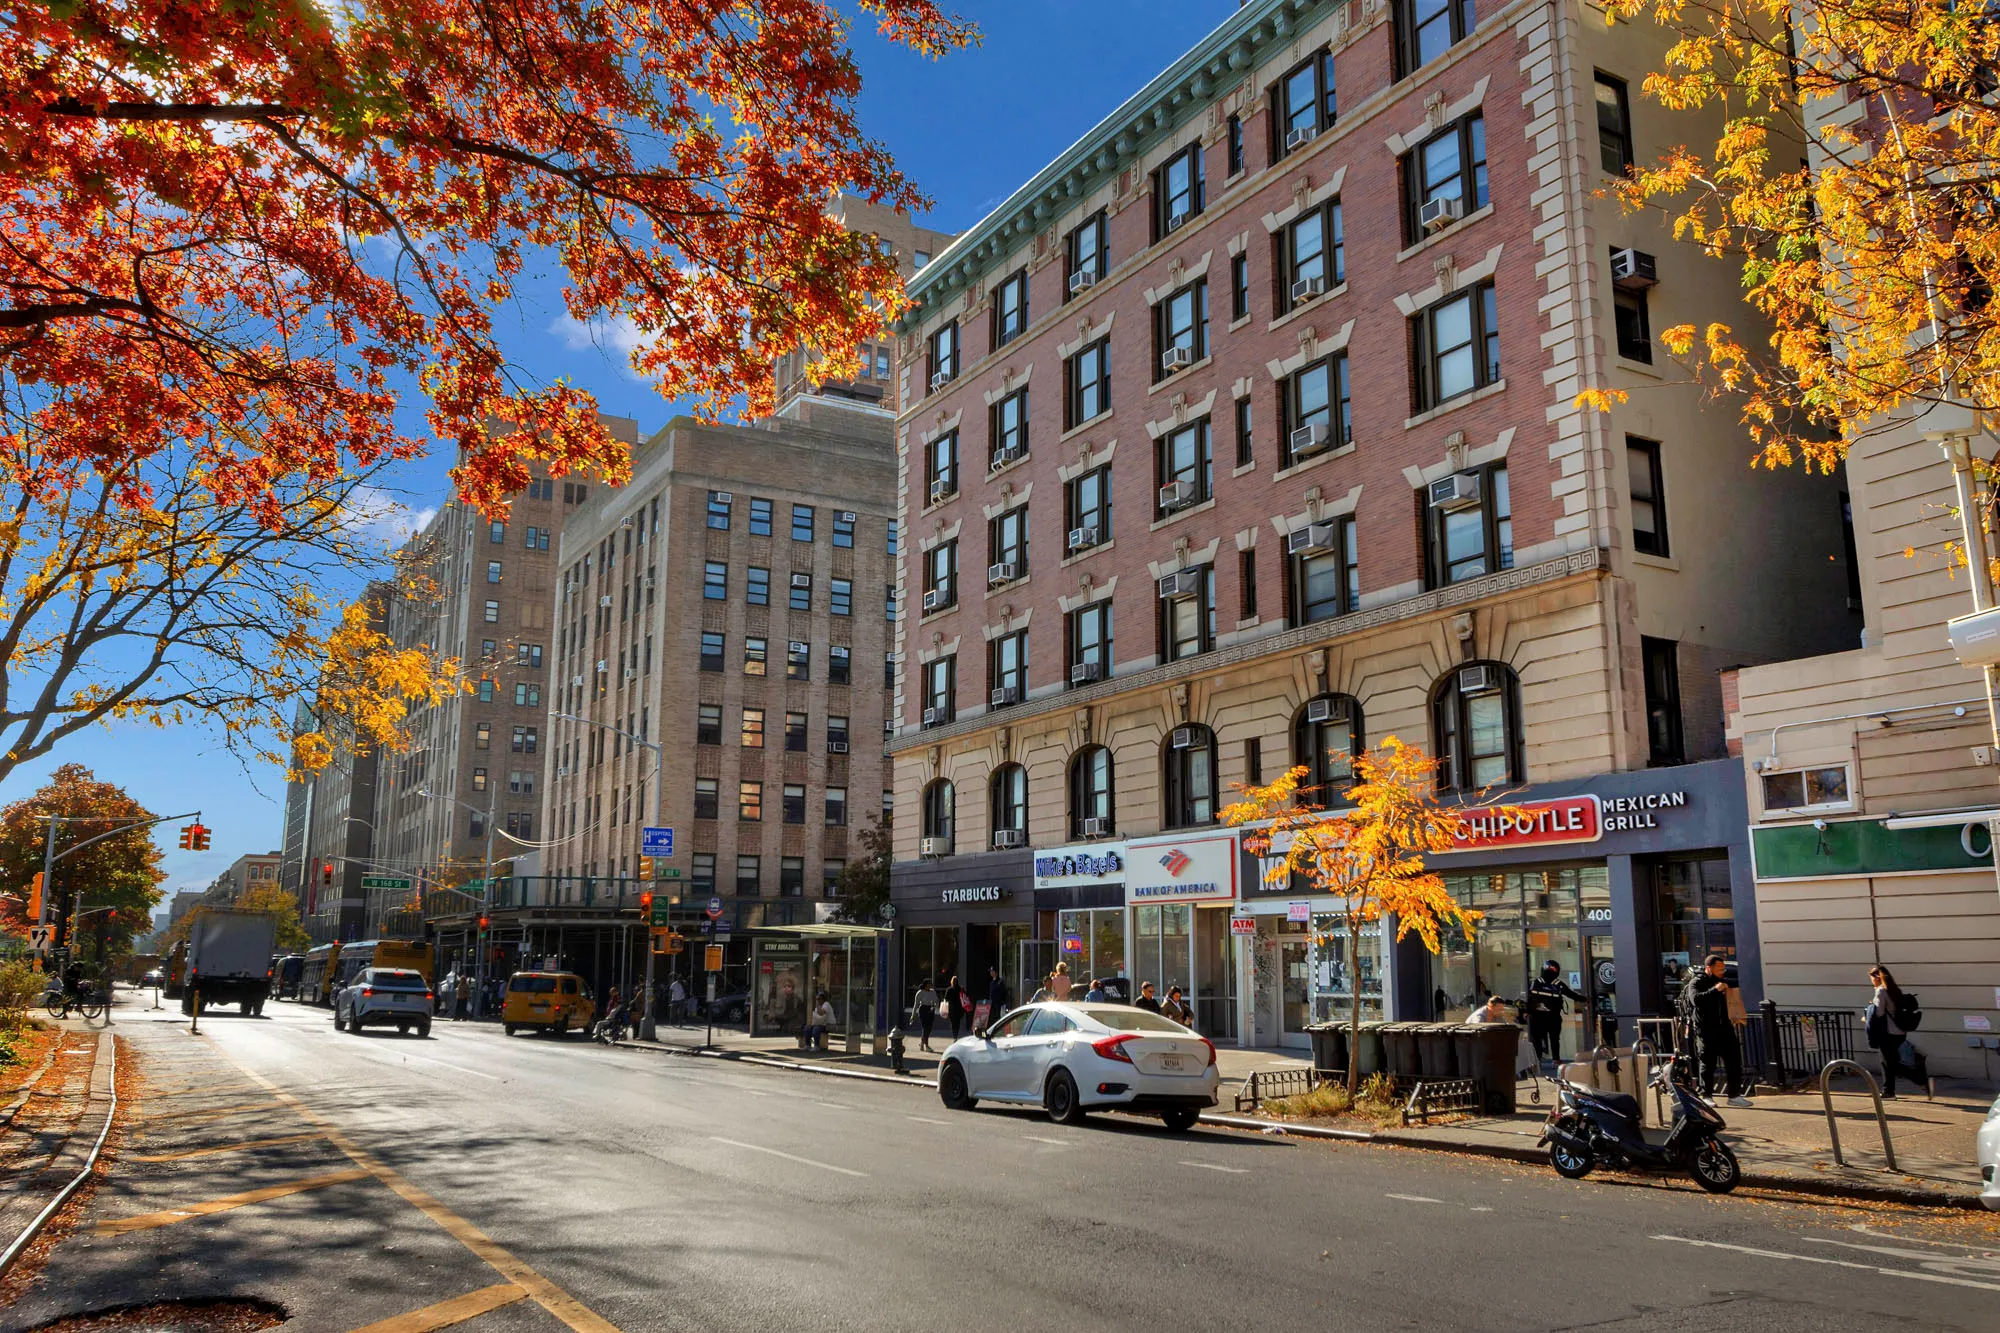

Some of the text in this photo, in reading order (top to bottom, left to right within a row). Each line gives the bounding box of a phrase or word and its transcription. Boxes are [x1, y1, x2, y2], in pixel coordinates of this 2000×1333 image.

[1602, 791, 1686, 813] MEXICAN
[1454, 807, 1584, 840] CHIPOTLE
[1604, 813, 1657, 831] GRILL
[644, 830, 672, 844] HOSPITAL
[1036, 851, 1118, 878] Mike's Bagels
[394, 880, 402, 888] St
[1135, 882, 1216, 897] BANK OF AMERICA
[942, 886, 999, 903] STARBUCKS
[1288, 906, 1308, 915] ATM
[1587, 909, 1612, 921] 400
[1232, 919, 1255, 929] ATM
[764, 943, 800, 951] STAY AMAZING
[1571, 974, 1579, 985] A
